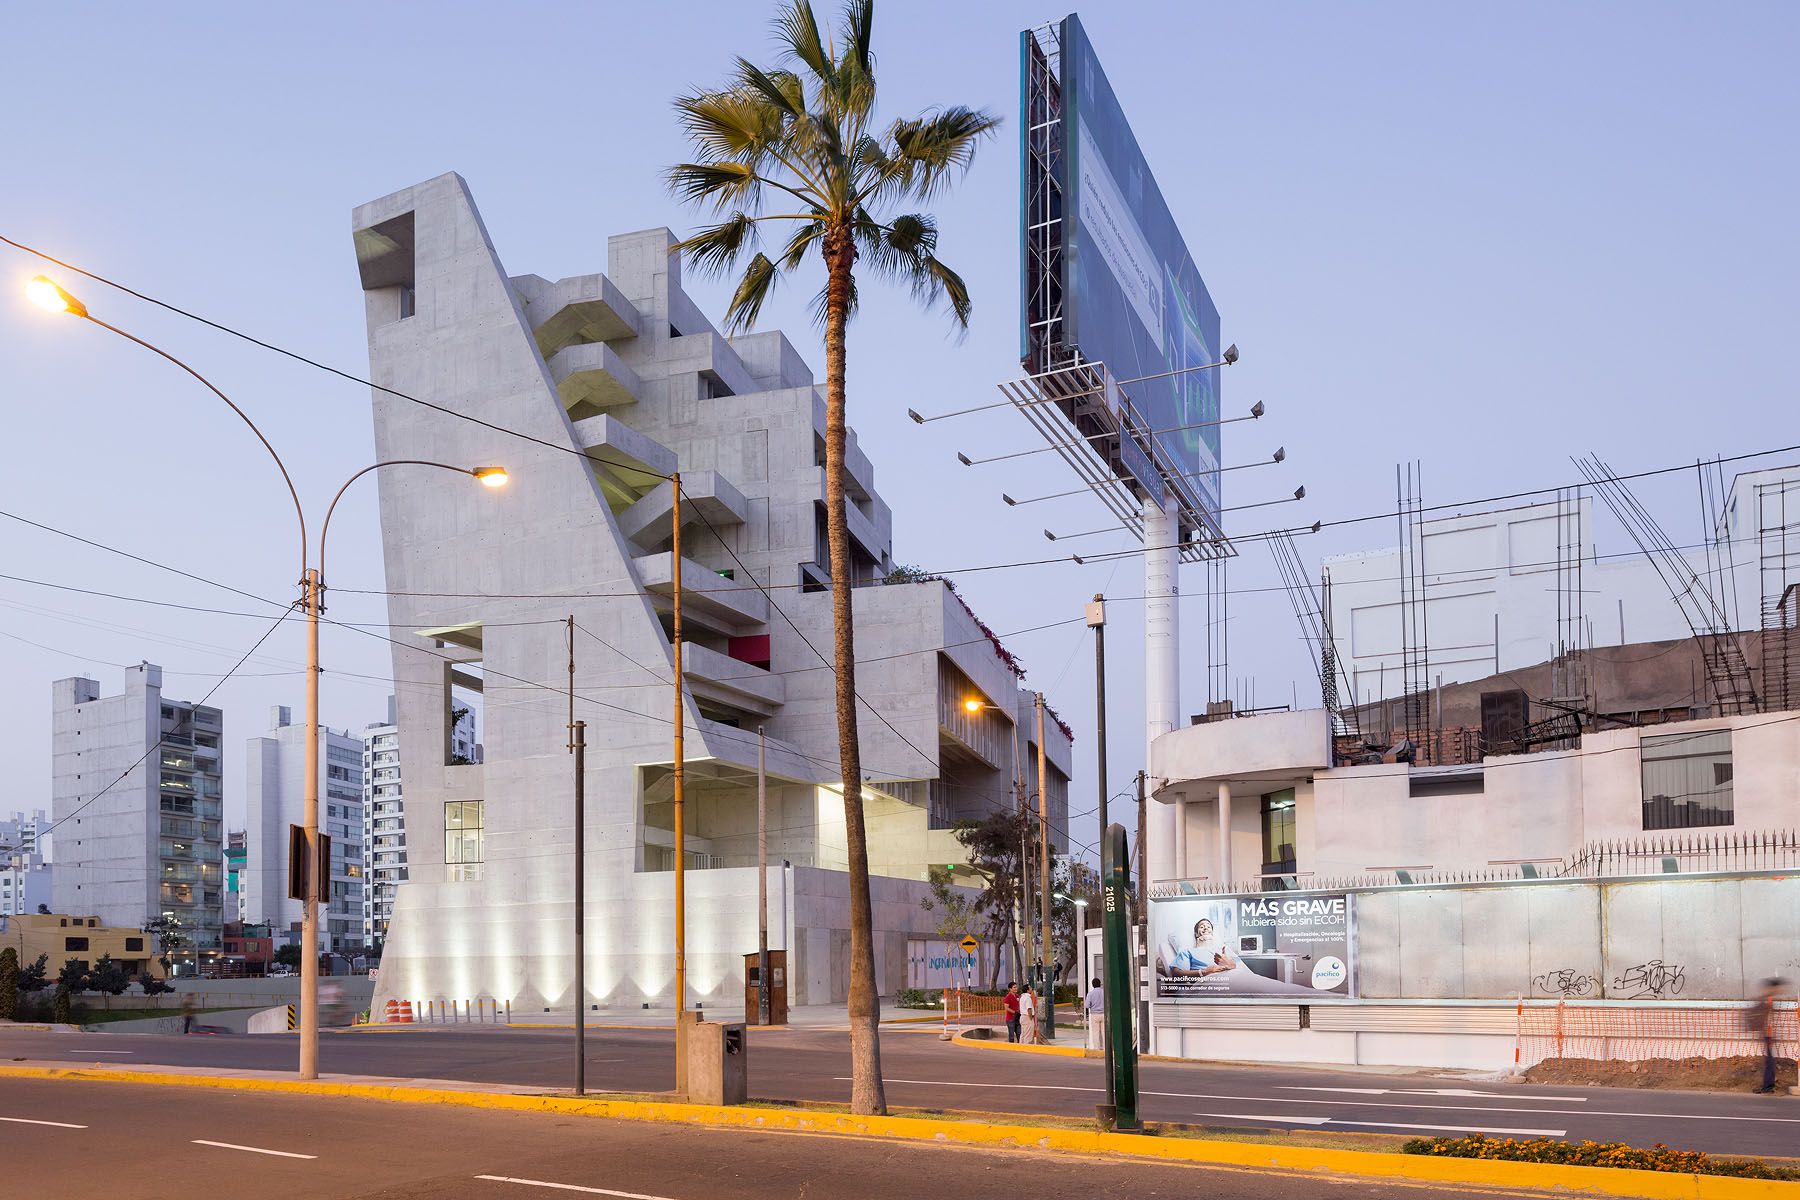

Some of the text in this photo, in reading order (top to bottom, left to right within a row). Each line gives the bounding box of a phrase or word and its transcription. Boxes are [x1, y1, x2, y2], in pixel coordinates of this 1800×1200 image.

[1105, 886, 1115, 912] 21025
[1241, 898, 1345, 917] MÁS GRAVE
[1241, 915, 1345, 927] hubiera sido sin ECOH
